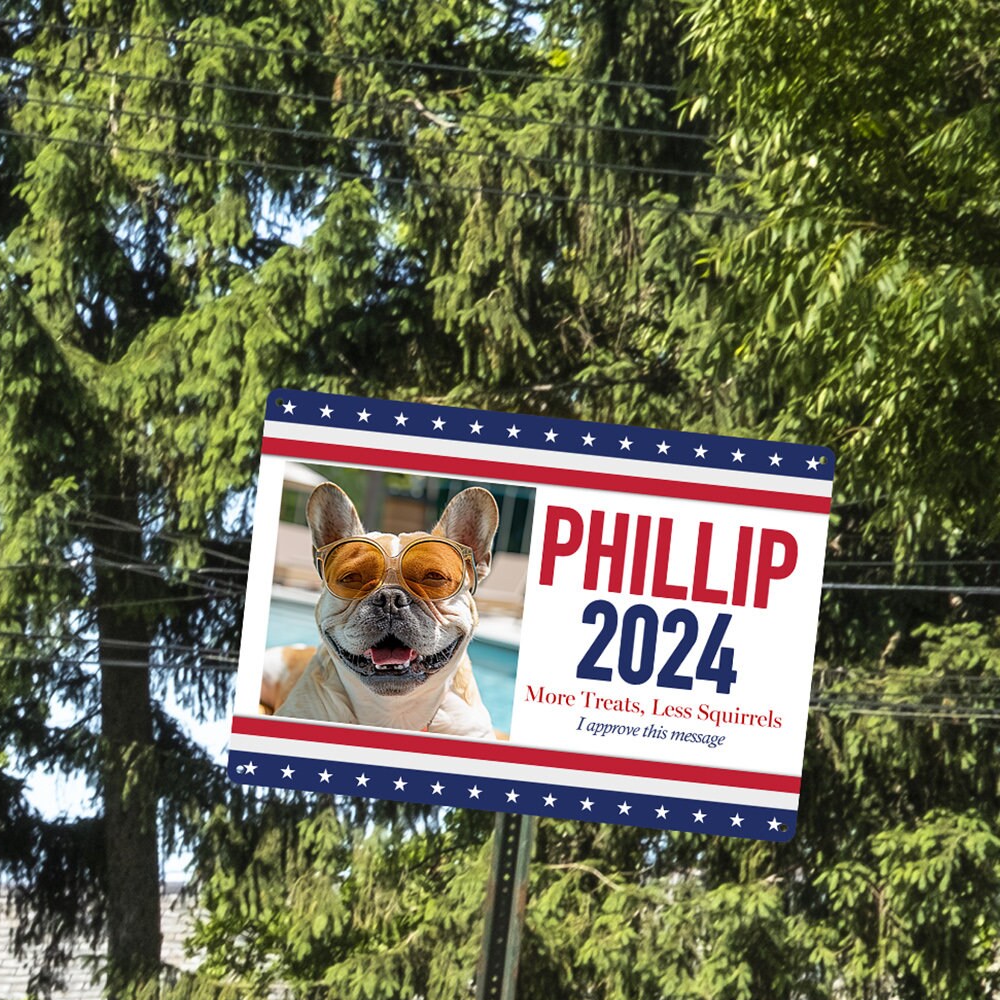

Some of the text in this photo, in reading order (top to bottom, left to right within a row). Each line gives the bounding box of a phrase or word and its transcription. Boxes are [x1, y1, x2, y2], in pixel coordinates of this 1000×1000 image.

[538, 504, 799, 610] PHILLIP
[575, 598, 738, 695] 2024
[525, 684, 783, 730] More Treats, Less Squirrels
[575, 716, 727, 748] I approve this message
